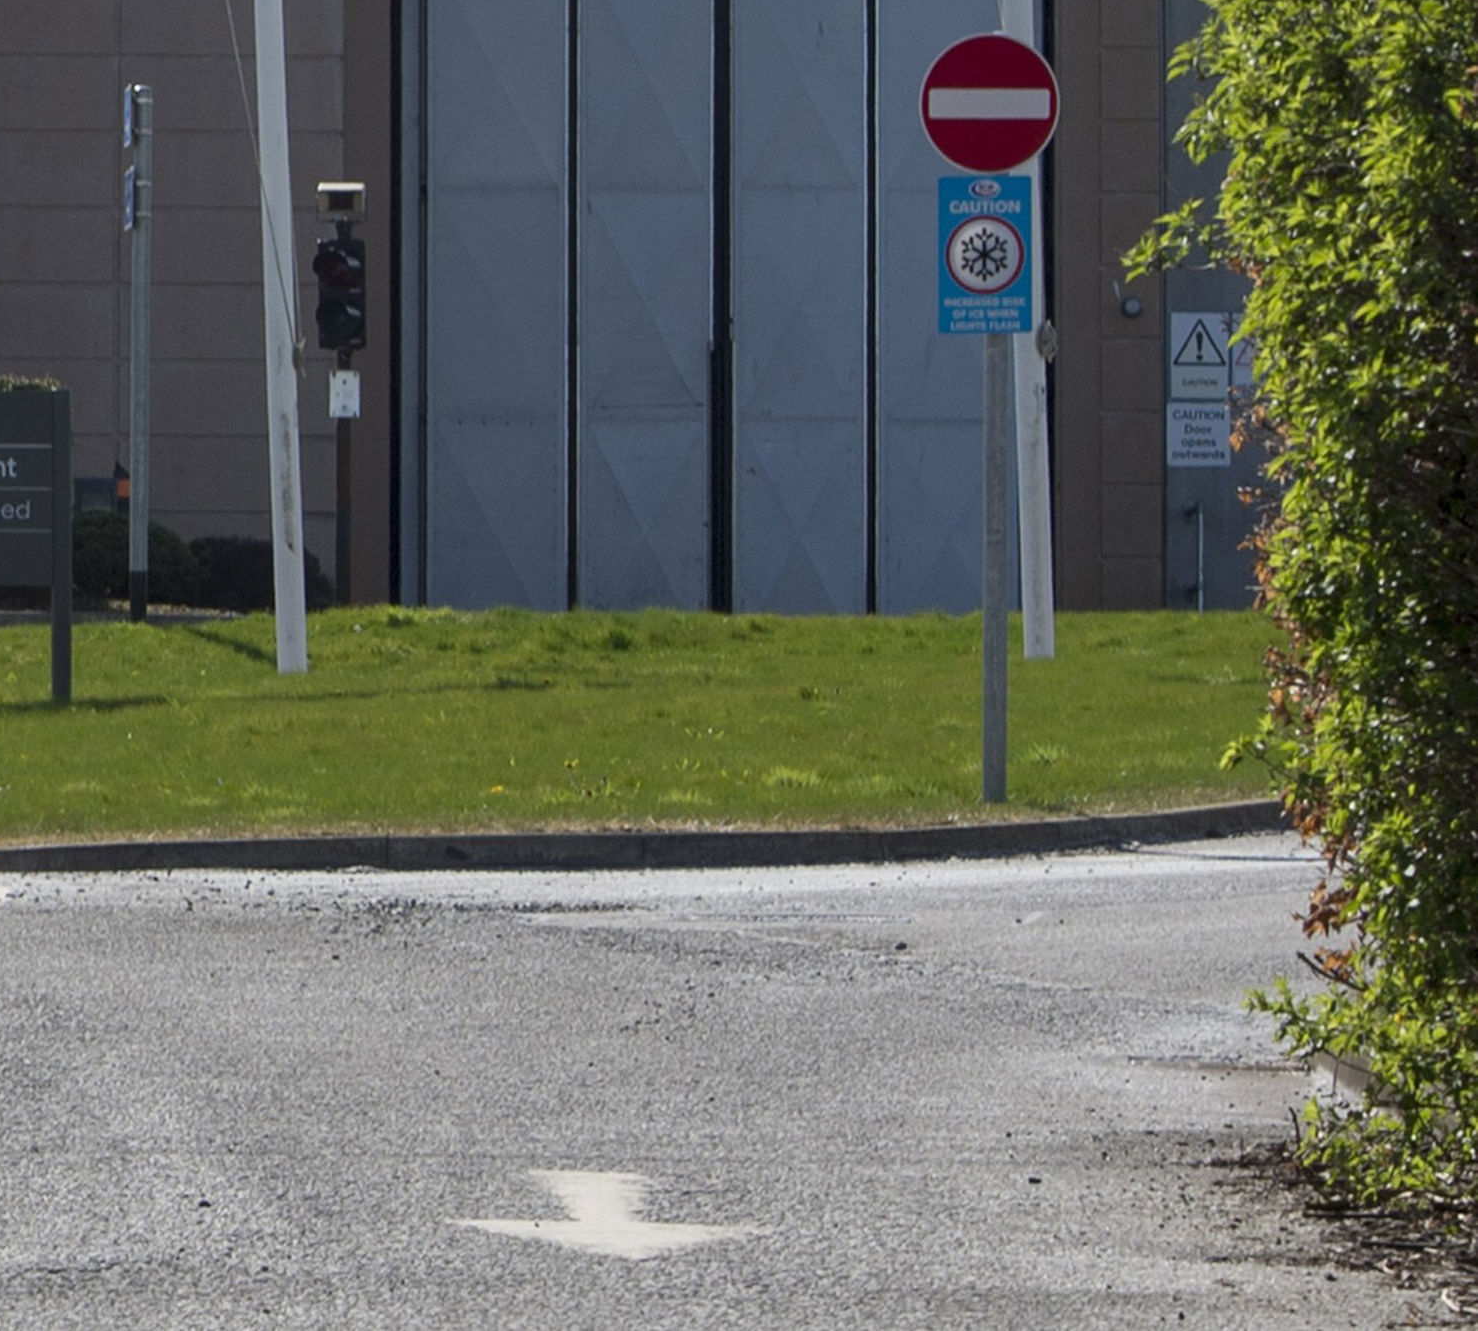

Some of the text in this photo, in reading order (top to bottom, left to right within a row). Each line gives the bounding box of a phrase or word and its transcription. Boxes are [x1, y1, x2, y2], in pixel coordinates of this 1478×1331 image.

[949, 200, 1021, 215] CAUTION
[952, 308, 966, 319] OF
[968, 308, 985, 319] ICE
[1172, 410, 1226, 421] CAUTION
[1184, 423, 1212, 435] Door
